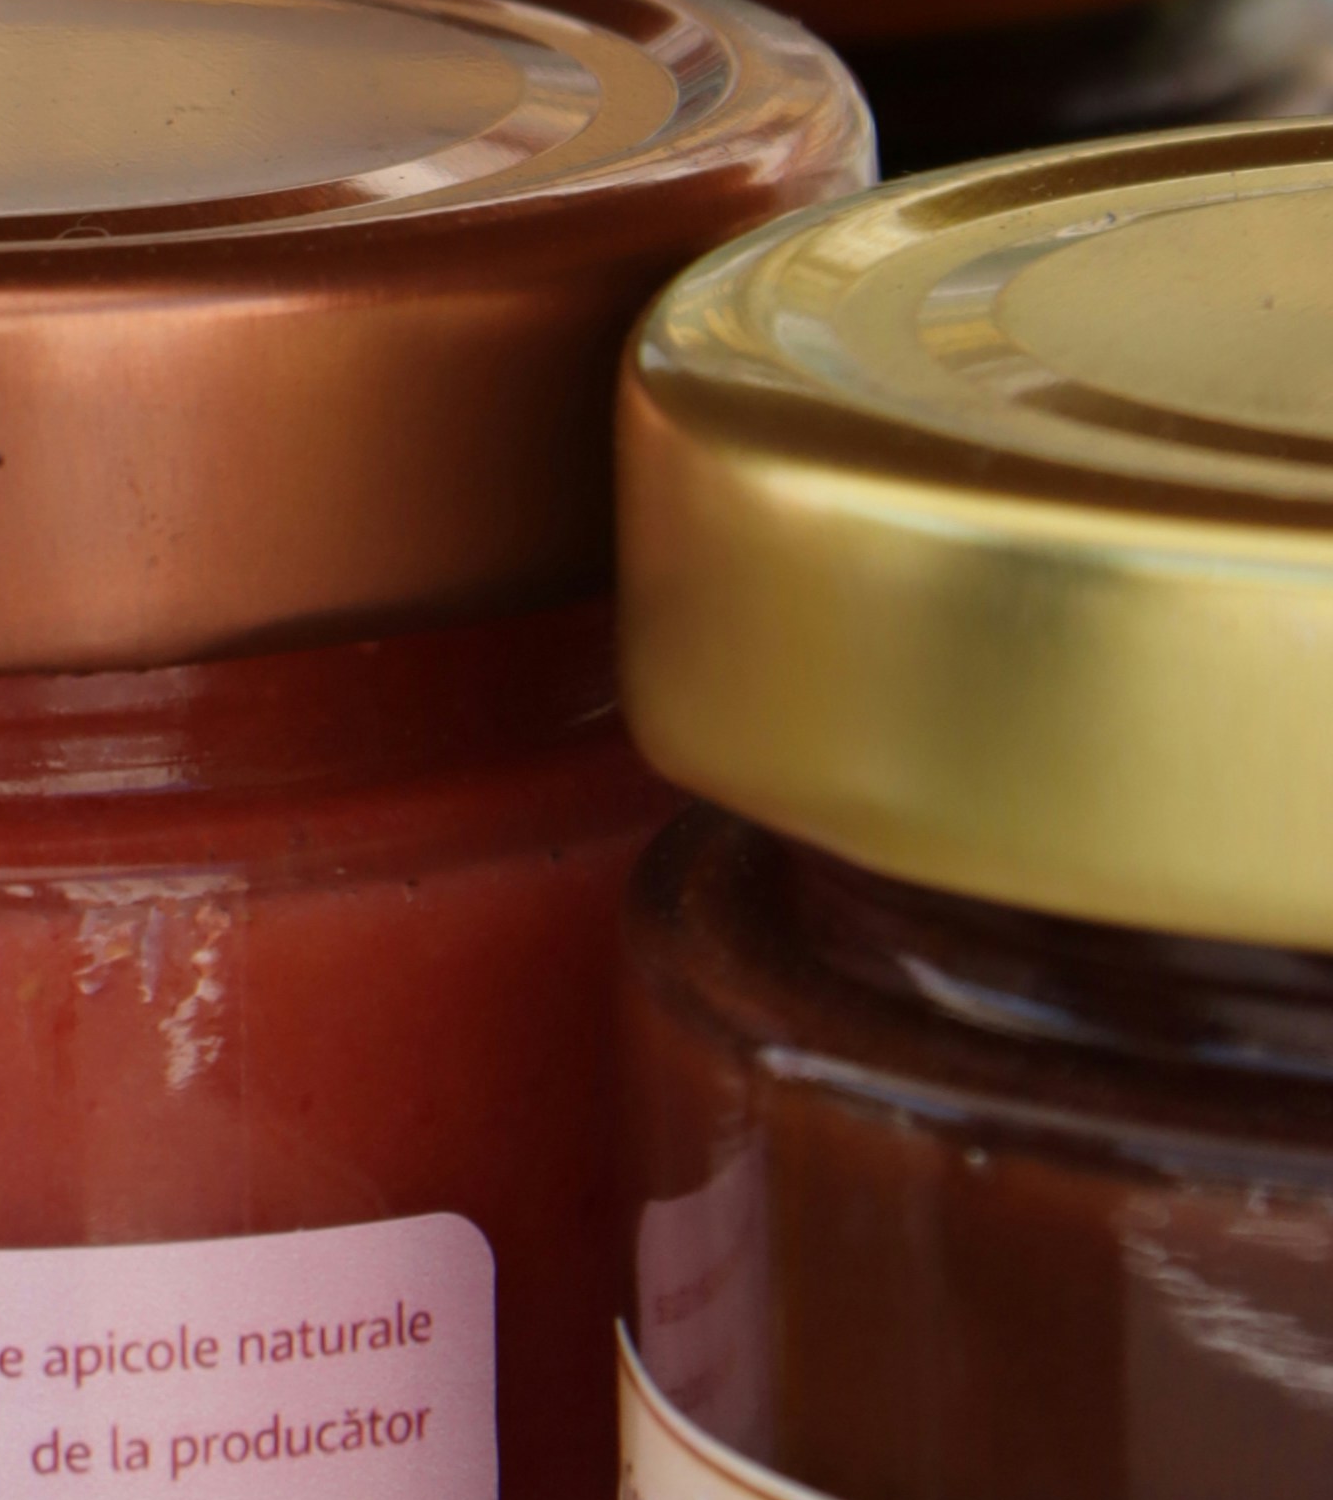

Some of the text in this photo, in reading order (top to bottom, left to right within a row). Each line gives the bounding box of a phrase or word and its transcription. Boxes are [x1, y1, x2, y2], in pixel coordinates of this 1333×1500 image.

[43, 1324, 219, 1388] apicole
[238, 1300, 434, 1366] naturale
[31, 1404, 433, 1481] de la producător
